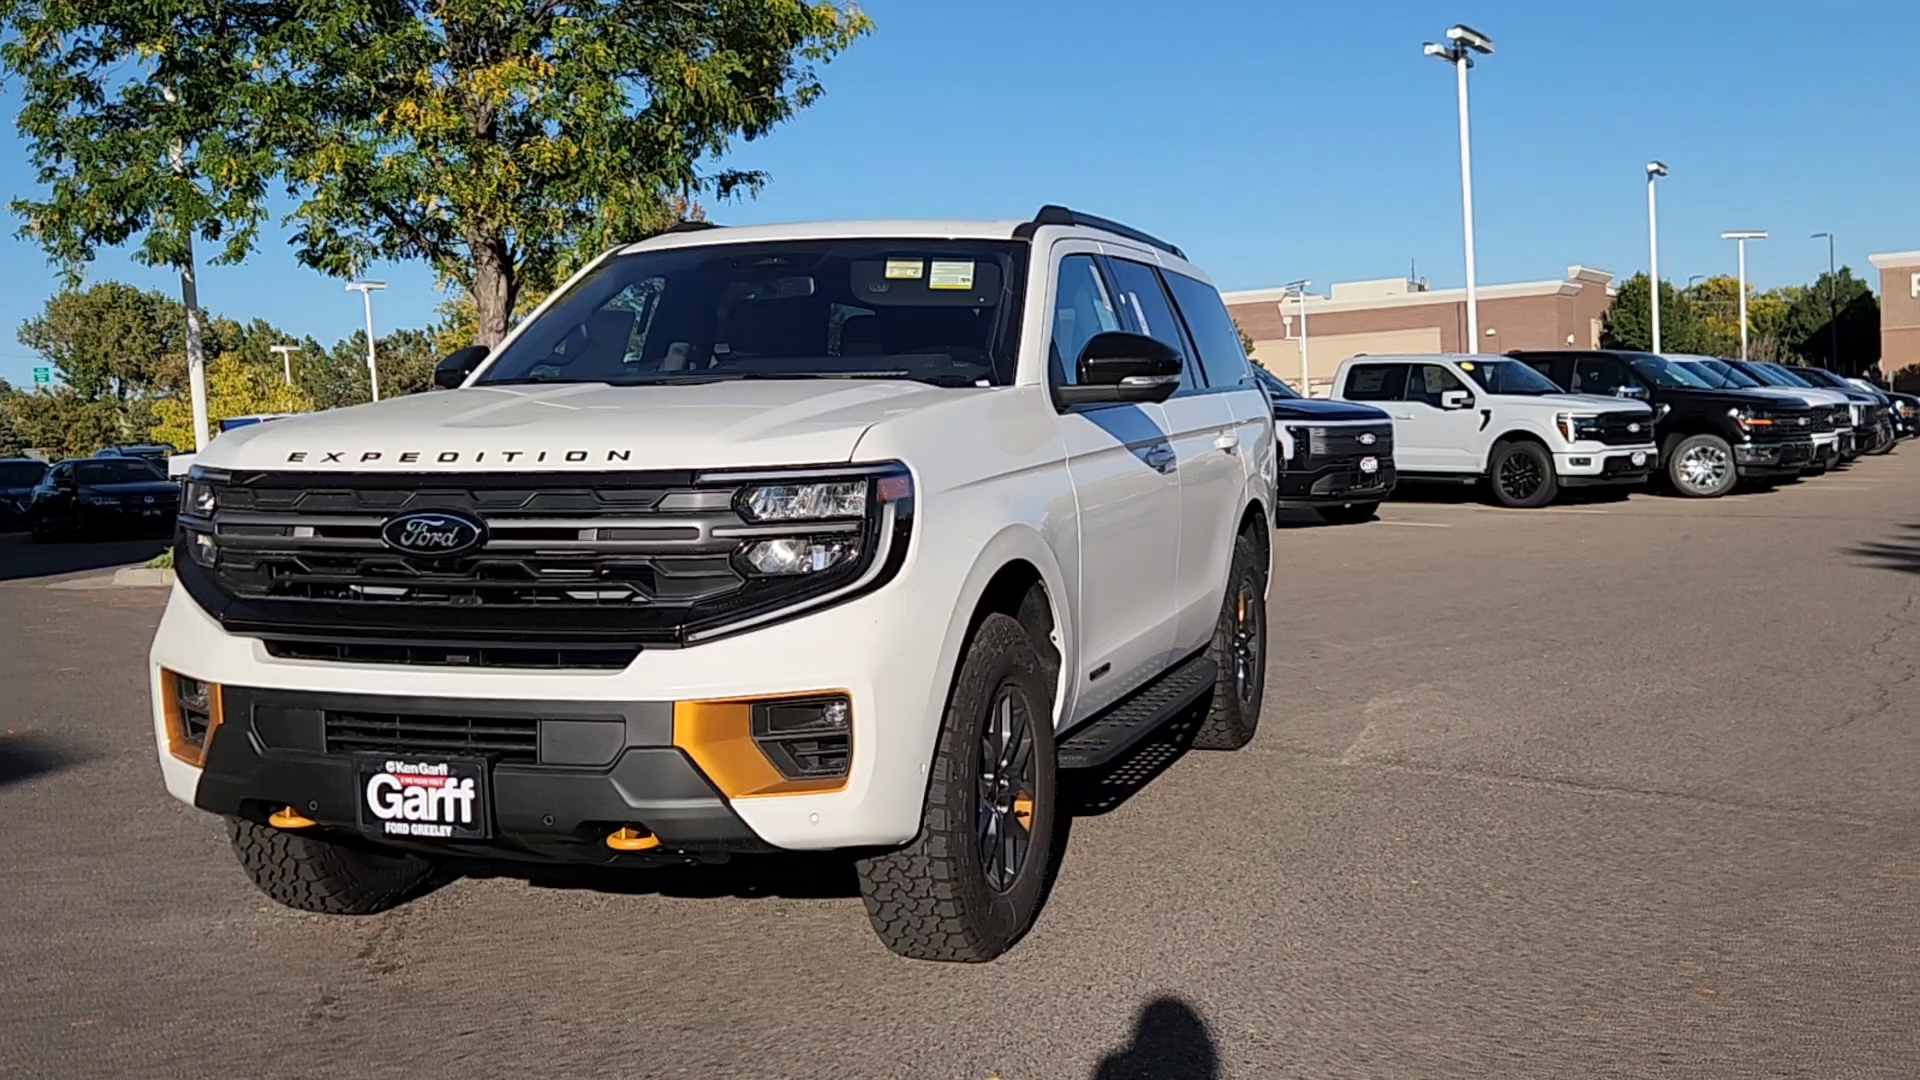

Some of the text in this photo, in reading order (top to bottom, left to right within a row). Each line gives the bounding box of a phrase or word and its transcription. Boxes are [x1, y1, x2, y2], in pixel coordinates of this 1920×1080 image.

[287, 450, 632, 463] EXPEDITION
[400, 518, 460, 547] Ford
[395, 760, 448, 775] Ken Garff
[366, 773, 475, 823] Garff
[385, 821, 452, 837] FORD GREELEY
